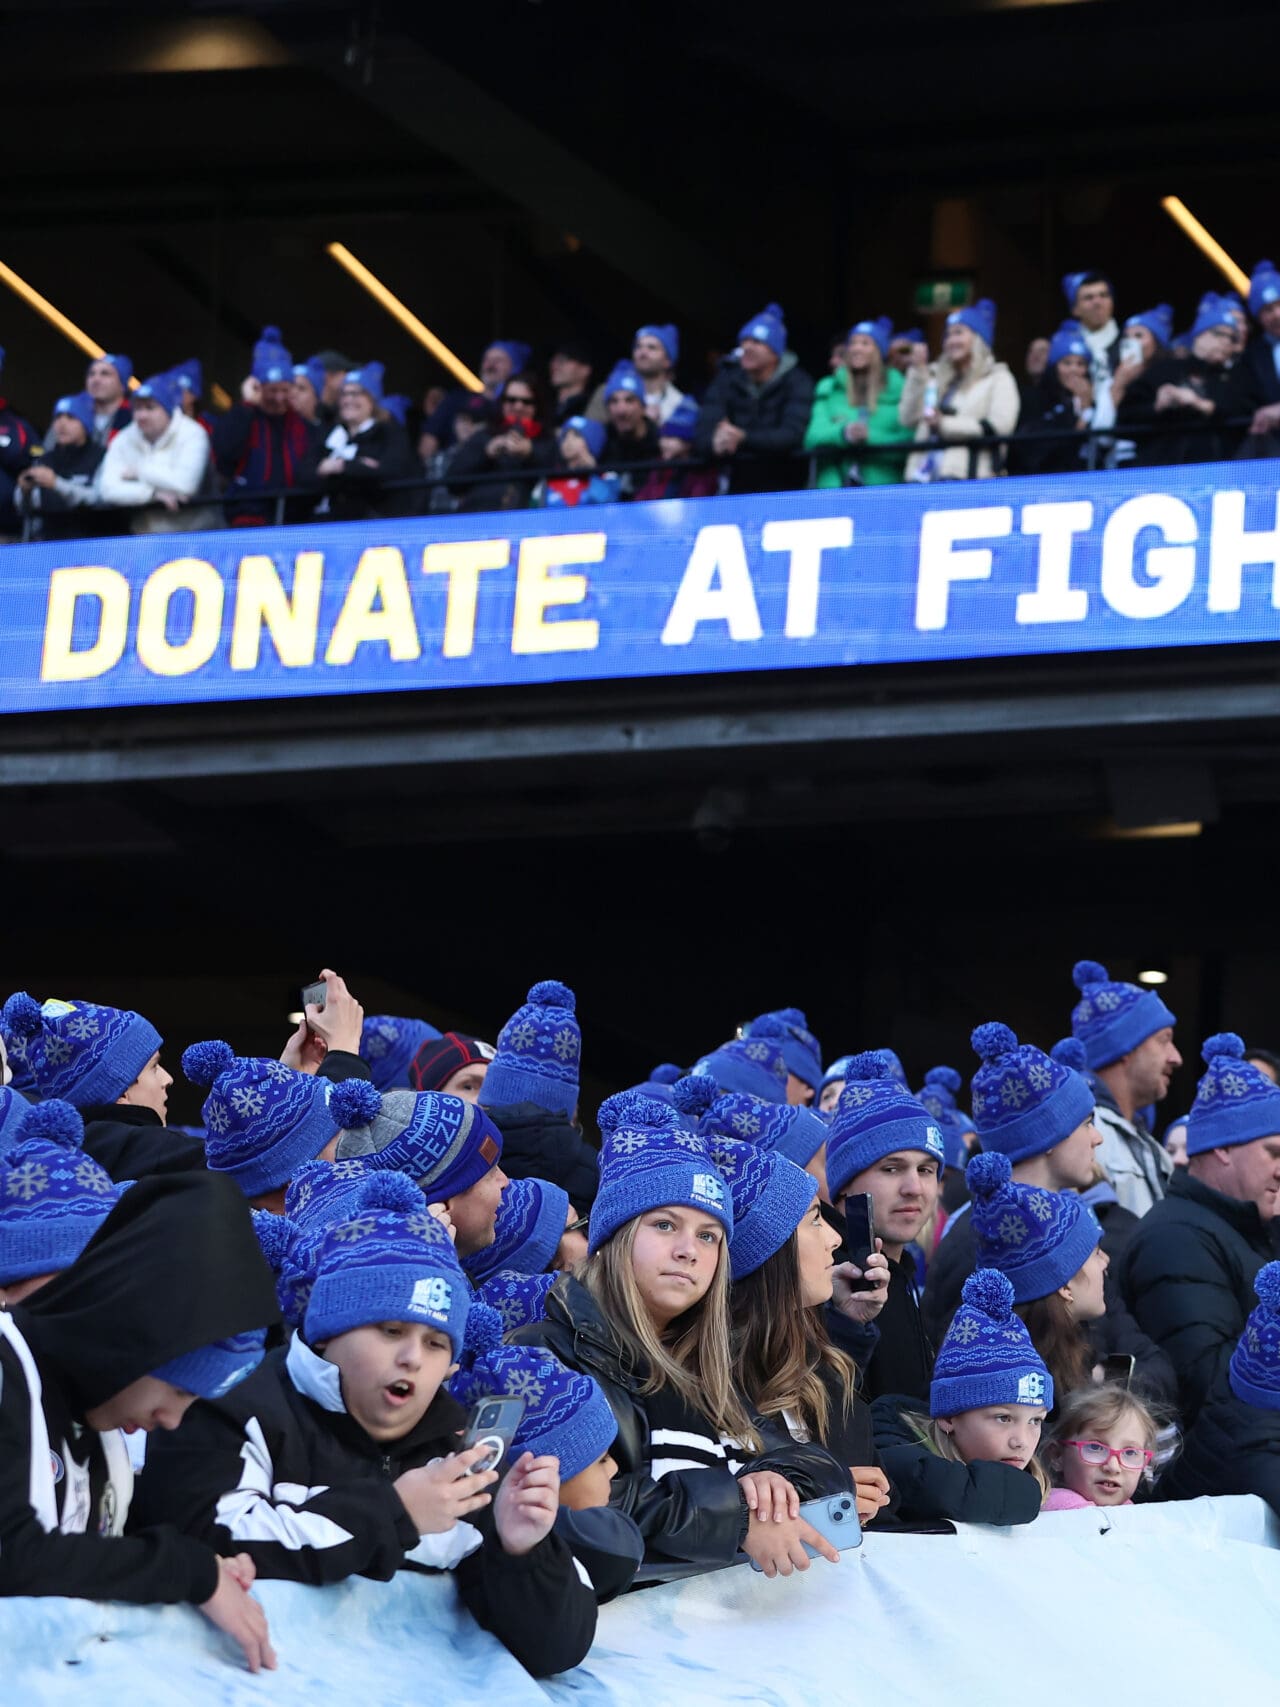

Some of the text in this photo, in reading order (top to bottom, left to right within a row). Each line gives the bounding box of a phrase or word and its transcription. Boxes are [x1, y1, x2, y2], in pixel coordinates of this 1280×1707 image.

[41, 531, 607, 683] DONATE
[660, 516, 854, 646] AT
[400, 1097, 462, 1178] REEZE 8
